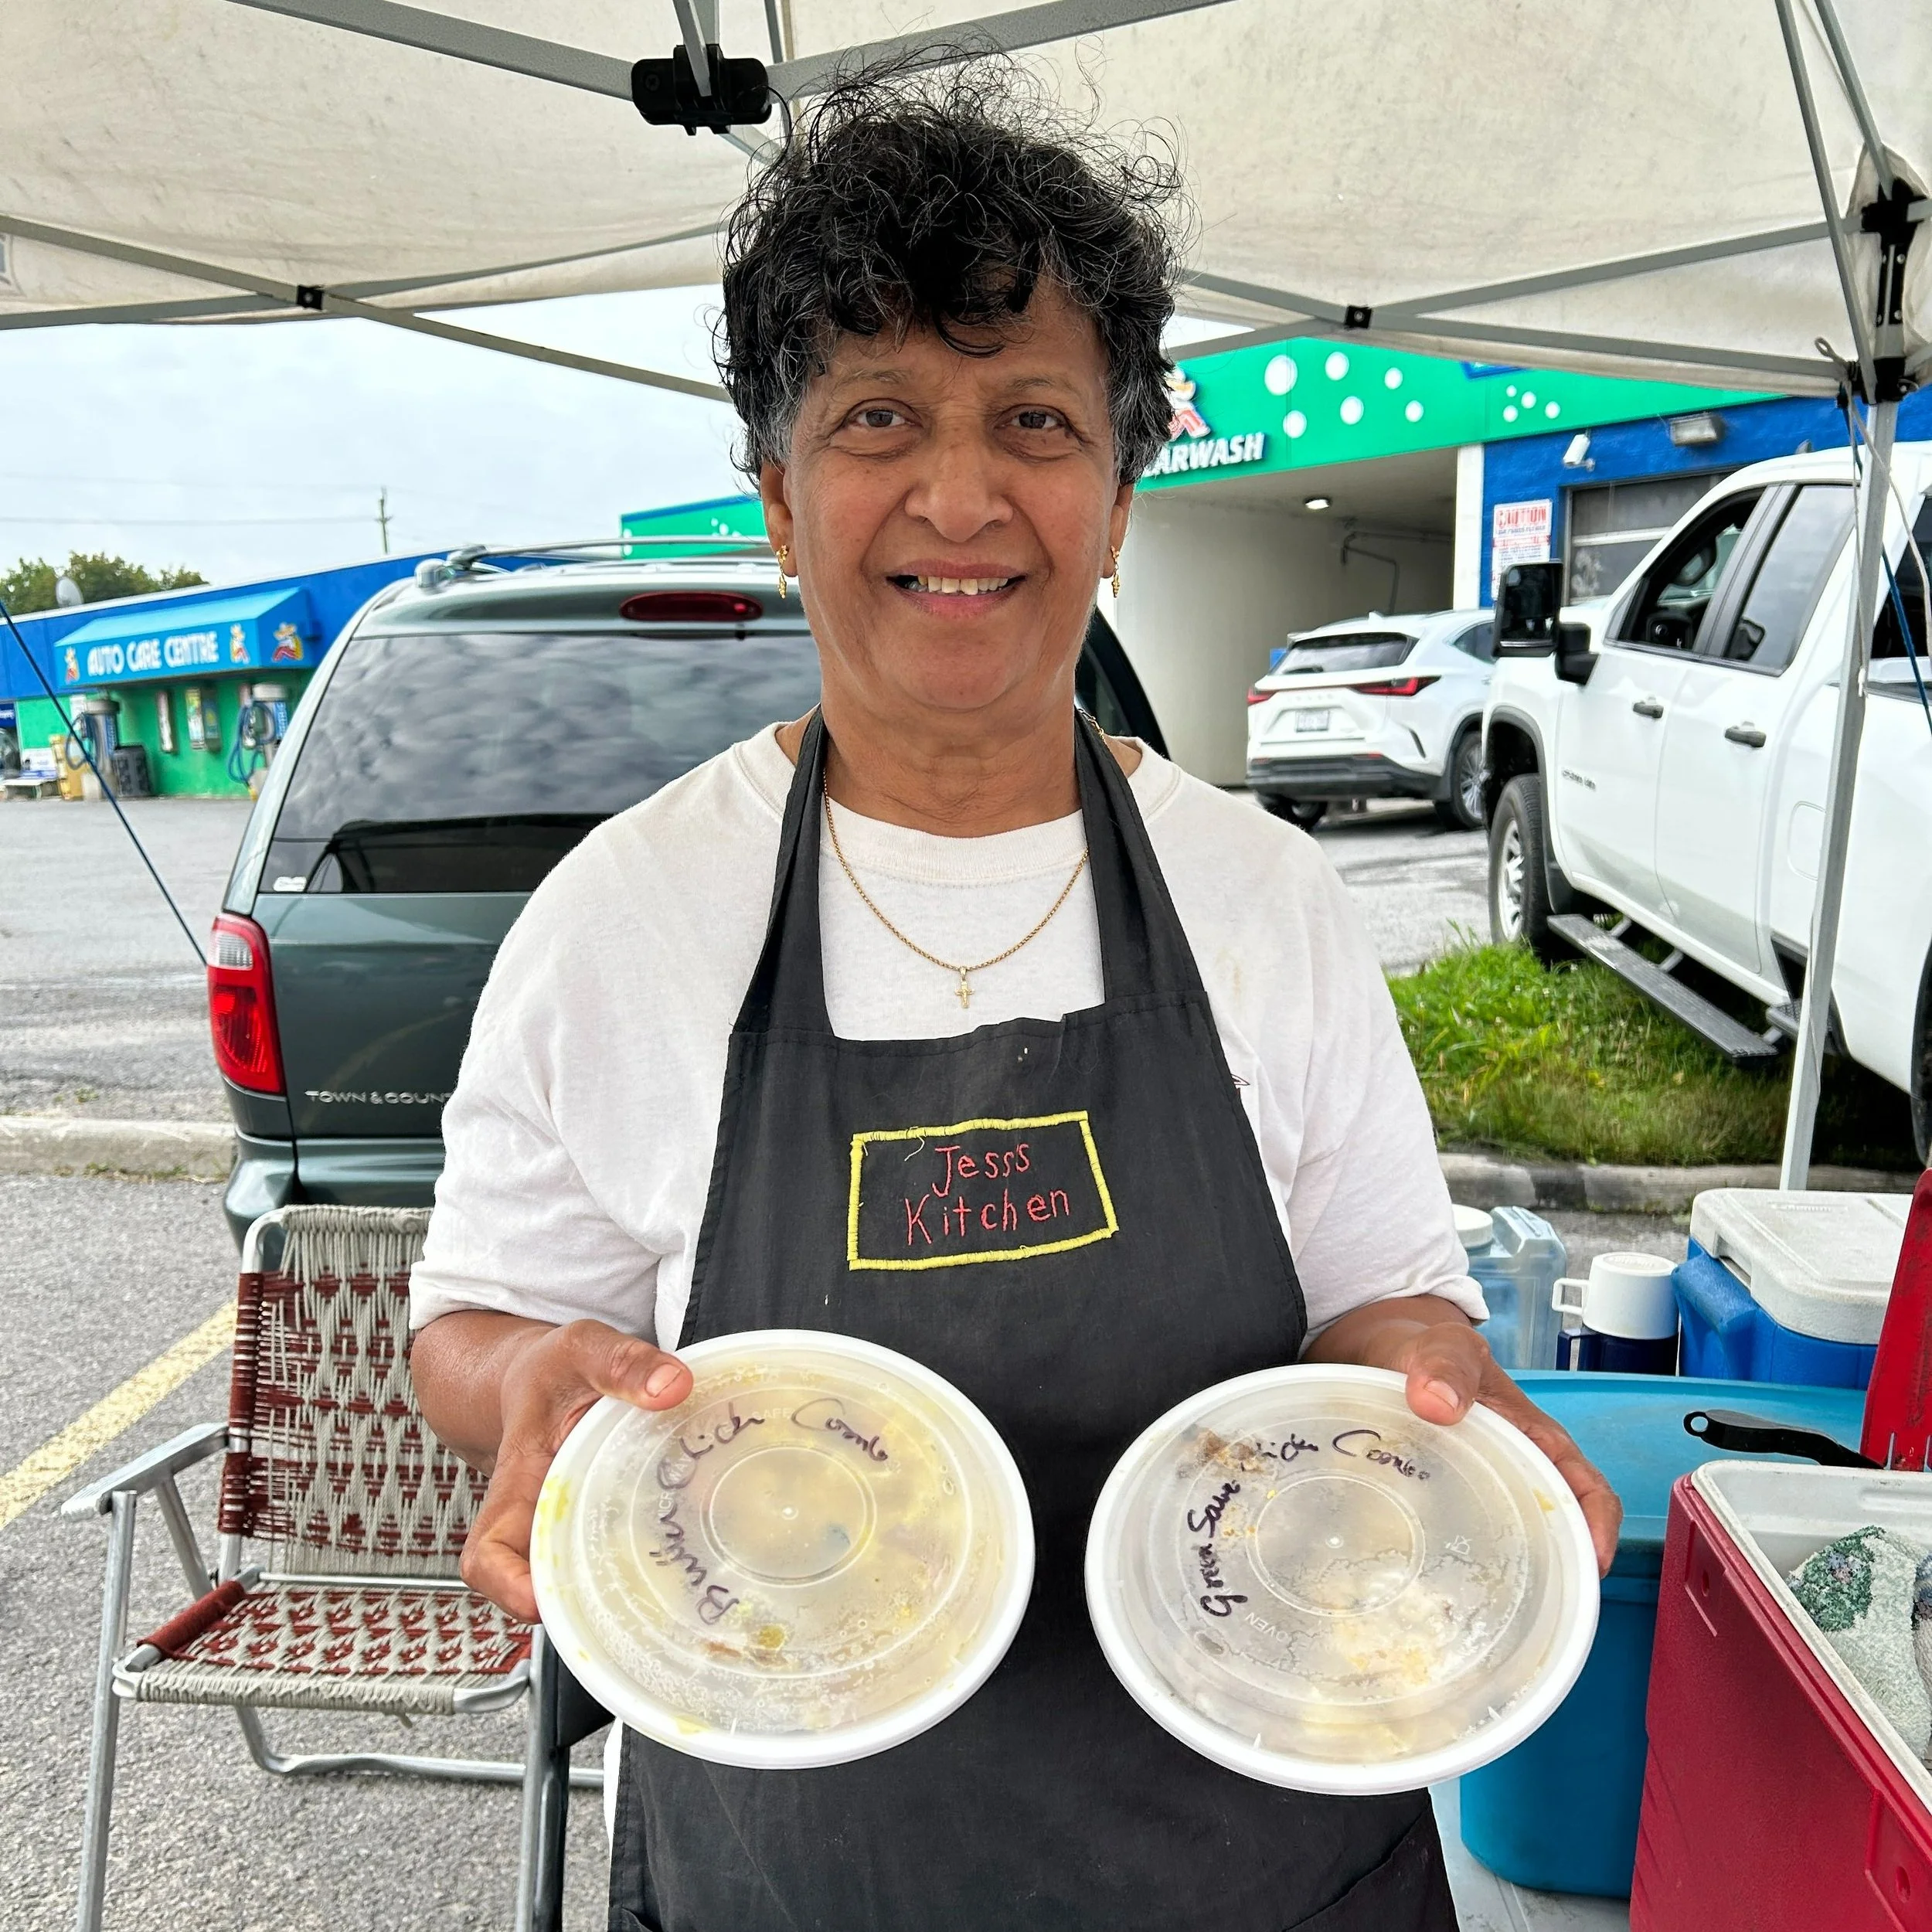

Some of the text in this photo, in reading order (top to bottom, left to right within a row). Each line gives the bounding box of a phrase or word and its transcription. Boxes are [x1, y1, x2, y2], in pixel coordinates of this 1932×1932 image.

[87, 631, 219, 677] AUTO CARE CENTRE
[304, 1090, 366, 1104] TOWN
[904, 1188, 1071, 1247] Kitchen
